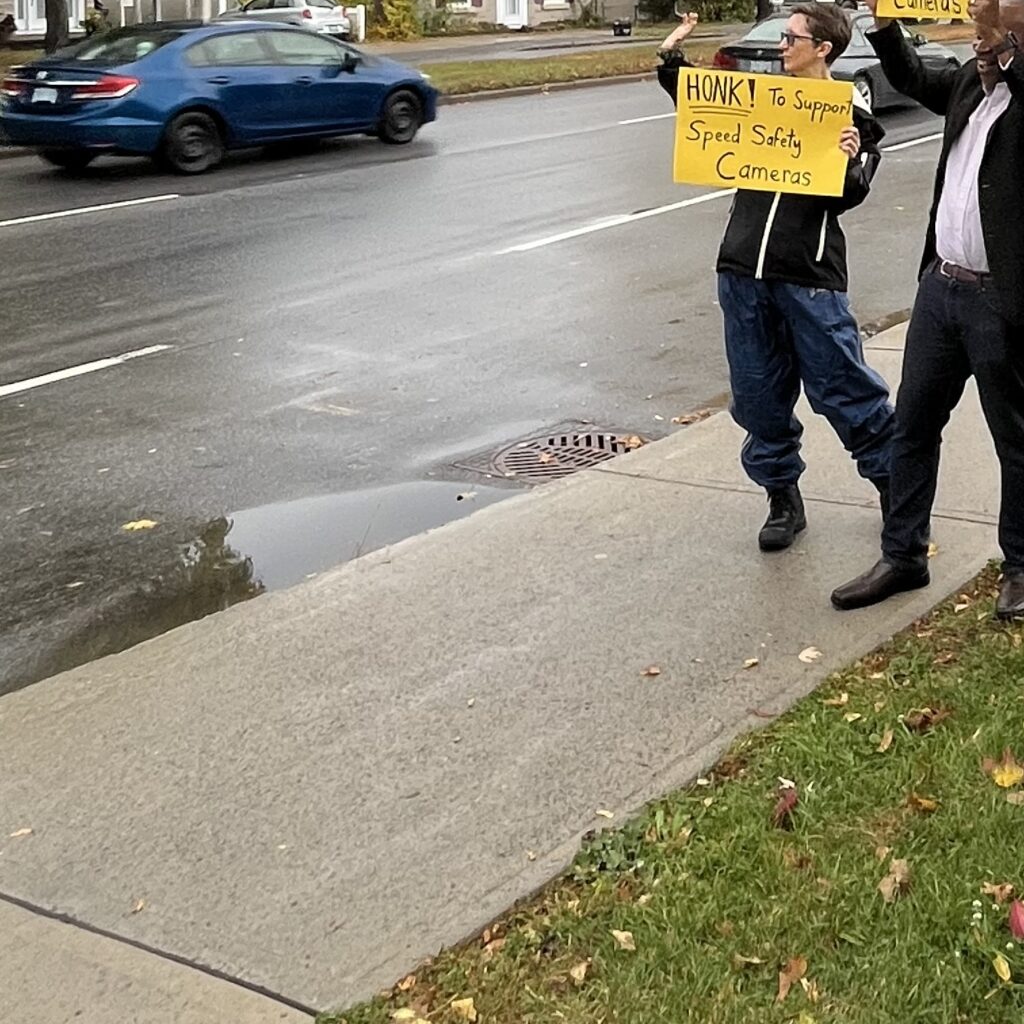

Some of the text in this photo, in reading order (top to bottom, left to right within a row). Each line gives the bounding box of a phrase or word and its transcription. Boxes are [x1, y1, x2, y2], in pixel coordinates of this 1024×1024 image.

[686, 74, 756, 108] HONK!
[768, 87, 786, 107] To
[686, 120, 802, 159] Speed Safety
[716, 151, 812, 187] Cameras
